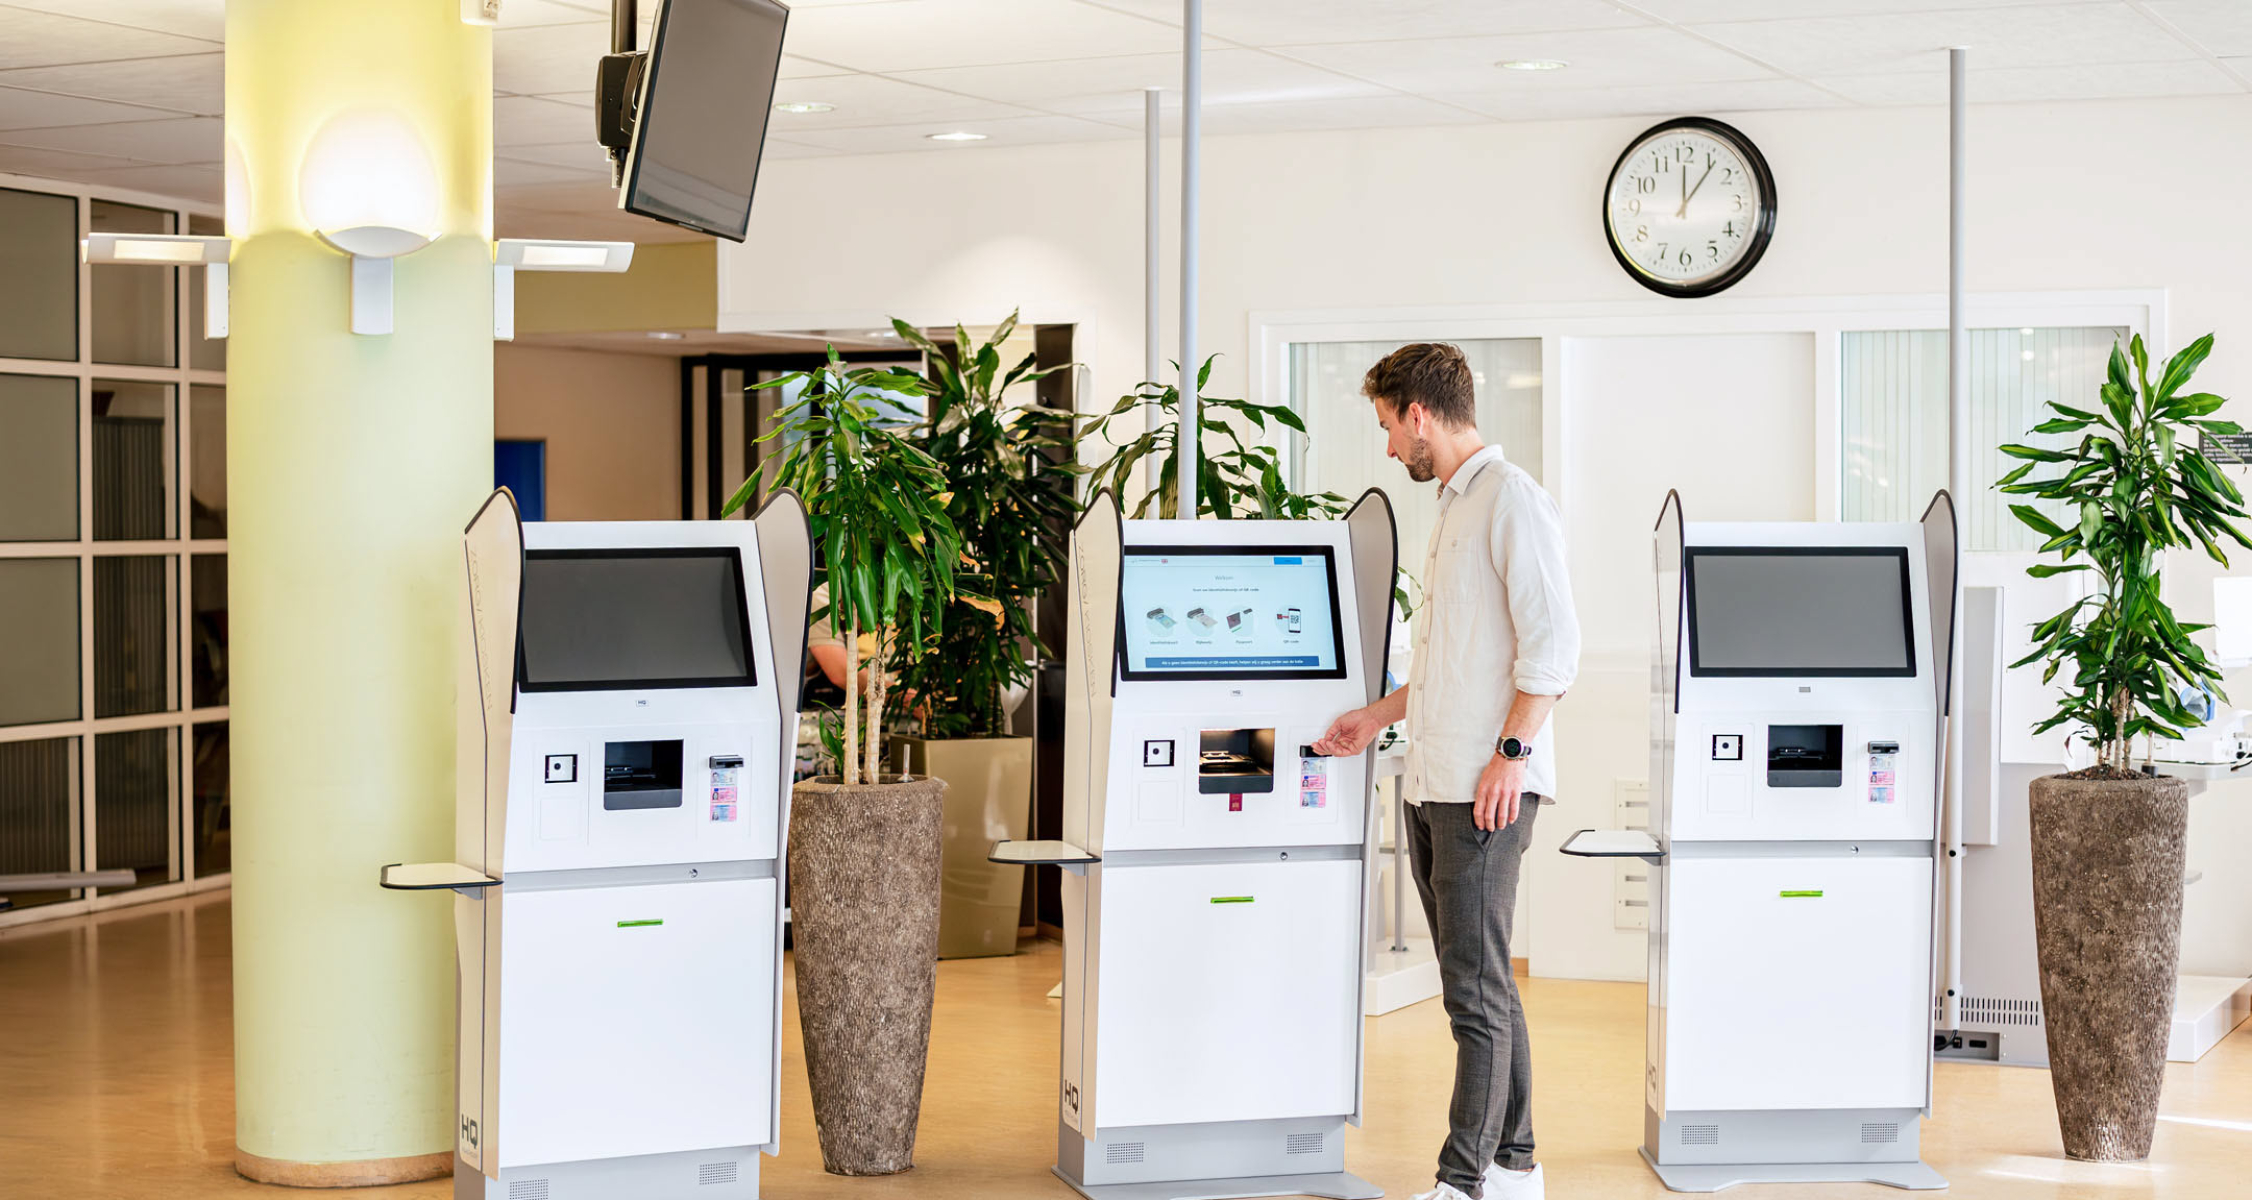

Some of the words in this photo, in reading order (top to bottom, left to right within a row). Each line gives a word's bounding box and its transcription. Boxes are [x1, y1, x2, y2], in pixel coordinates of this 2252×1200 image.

[1655, 155, 1669, 173] 11
[1676, 146, 1694, 164] 12
[1637, 176, 1656, 194] 10
[1720, 167, 1732, 185] 2
[1628, 199, 1641, 217] 9
[1732, 194, 1742, 212] 3
[1636, 224, 1649, 243] 8
[1722, 220, 1735, 237] 4
[1657, 242, 1668, 260] 7
[1679, 247, 1692, 266] 6
[1706, 240, 1718, 258] 5
[1064, 1078, 1079, 1115] HQ
[461, 1112, 478, 1150] HQ
